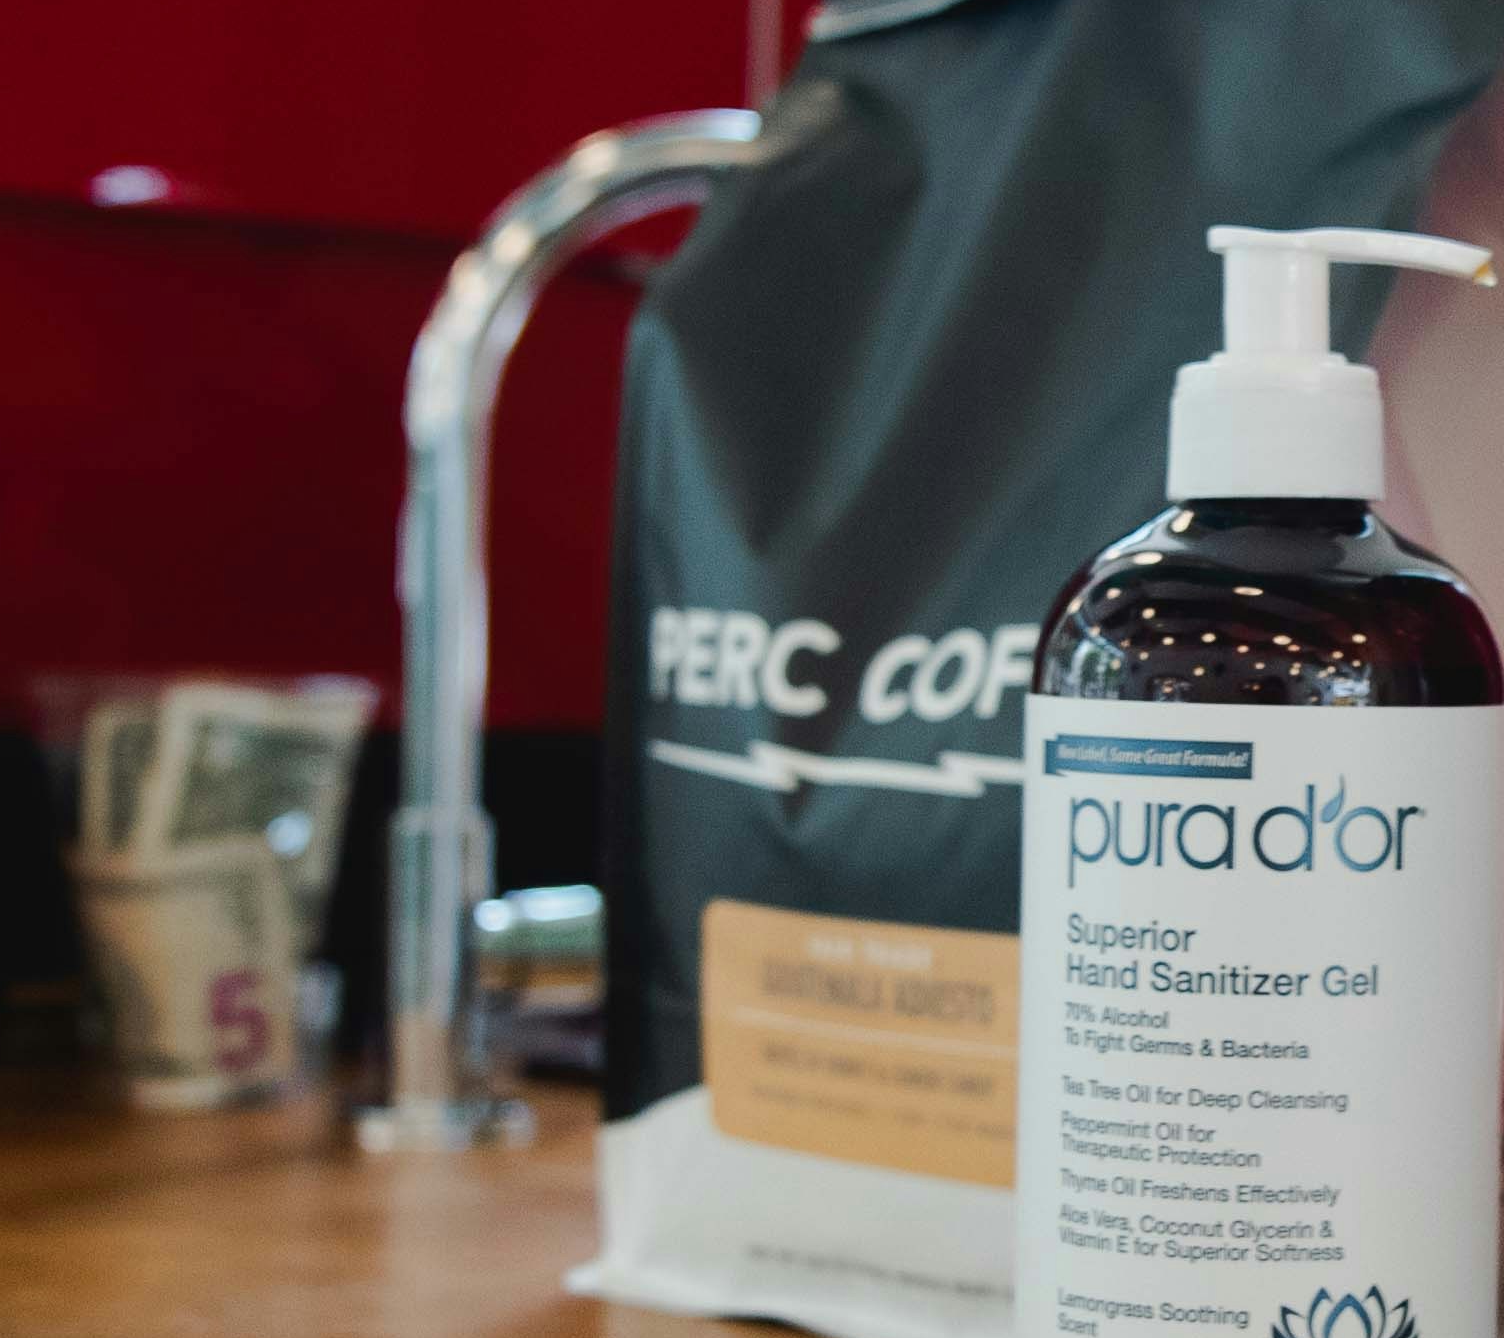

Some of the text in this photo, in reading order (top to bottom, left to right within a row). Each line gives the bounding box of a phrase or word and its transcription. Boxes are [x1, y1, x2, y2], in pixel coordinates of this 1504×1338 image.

[649, 606, 841, 717] PERC
[1183, 750, 1248, 768] Formula!
[1068, 797, 1236, 889] pura
[1066, 912, 1196, 953] Superior
[1066, 953, 1379, 996] Hand Sanitizer Gel
[1064, 1002, 1170, 1029] 70% Alcohol
[1064, 1027, 1310, 1059] To Fight Germs & Bacteria
[1061, 1076, 1349, 1113] Tea Tree Oil for Deep Cleansing
[1061, 1110, 1216, 1143] Peppermint Oil for
[1060, 1133, 1261, 1168] Therapeutic Protection
[1060, 1168, 1341, 1207] Thyme Oil Freshens Effectively
[1059, 1204, 1335, 1243] Aloe Vera, Coconut Glycerin &
[1059, 1226, 1345, 1263] Vitamin E for Superior Softness
[1057, 1288, 1251, 1329] Lemongrass Soothing
[1057, 1312, 1098, 1337] Scent
